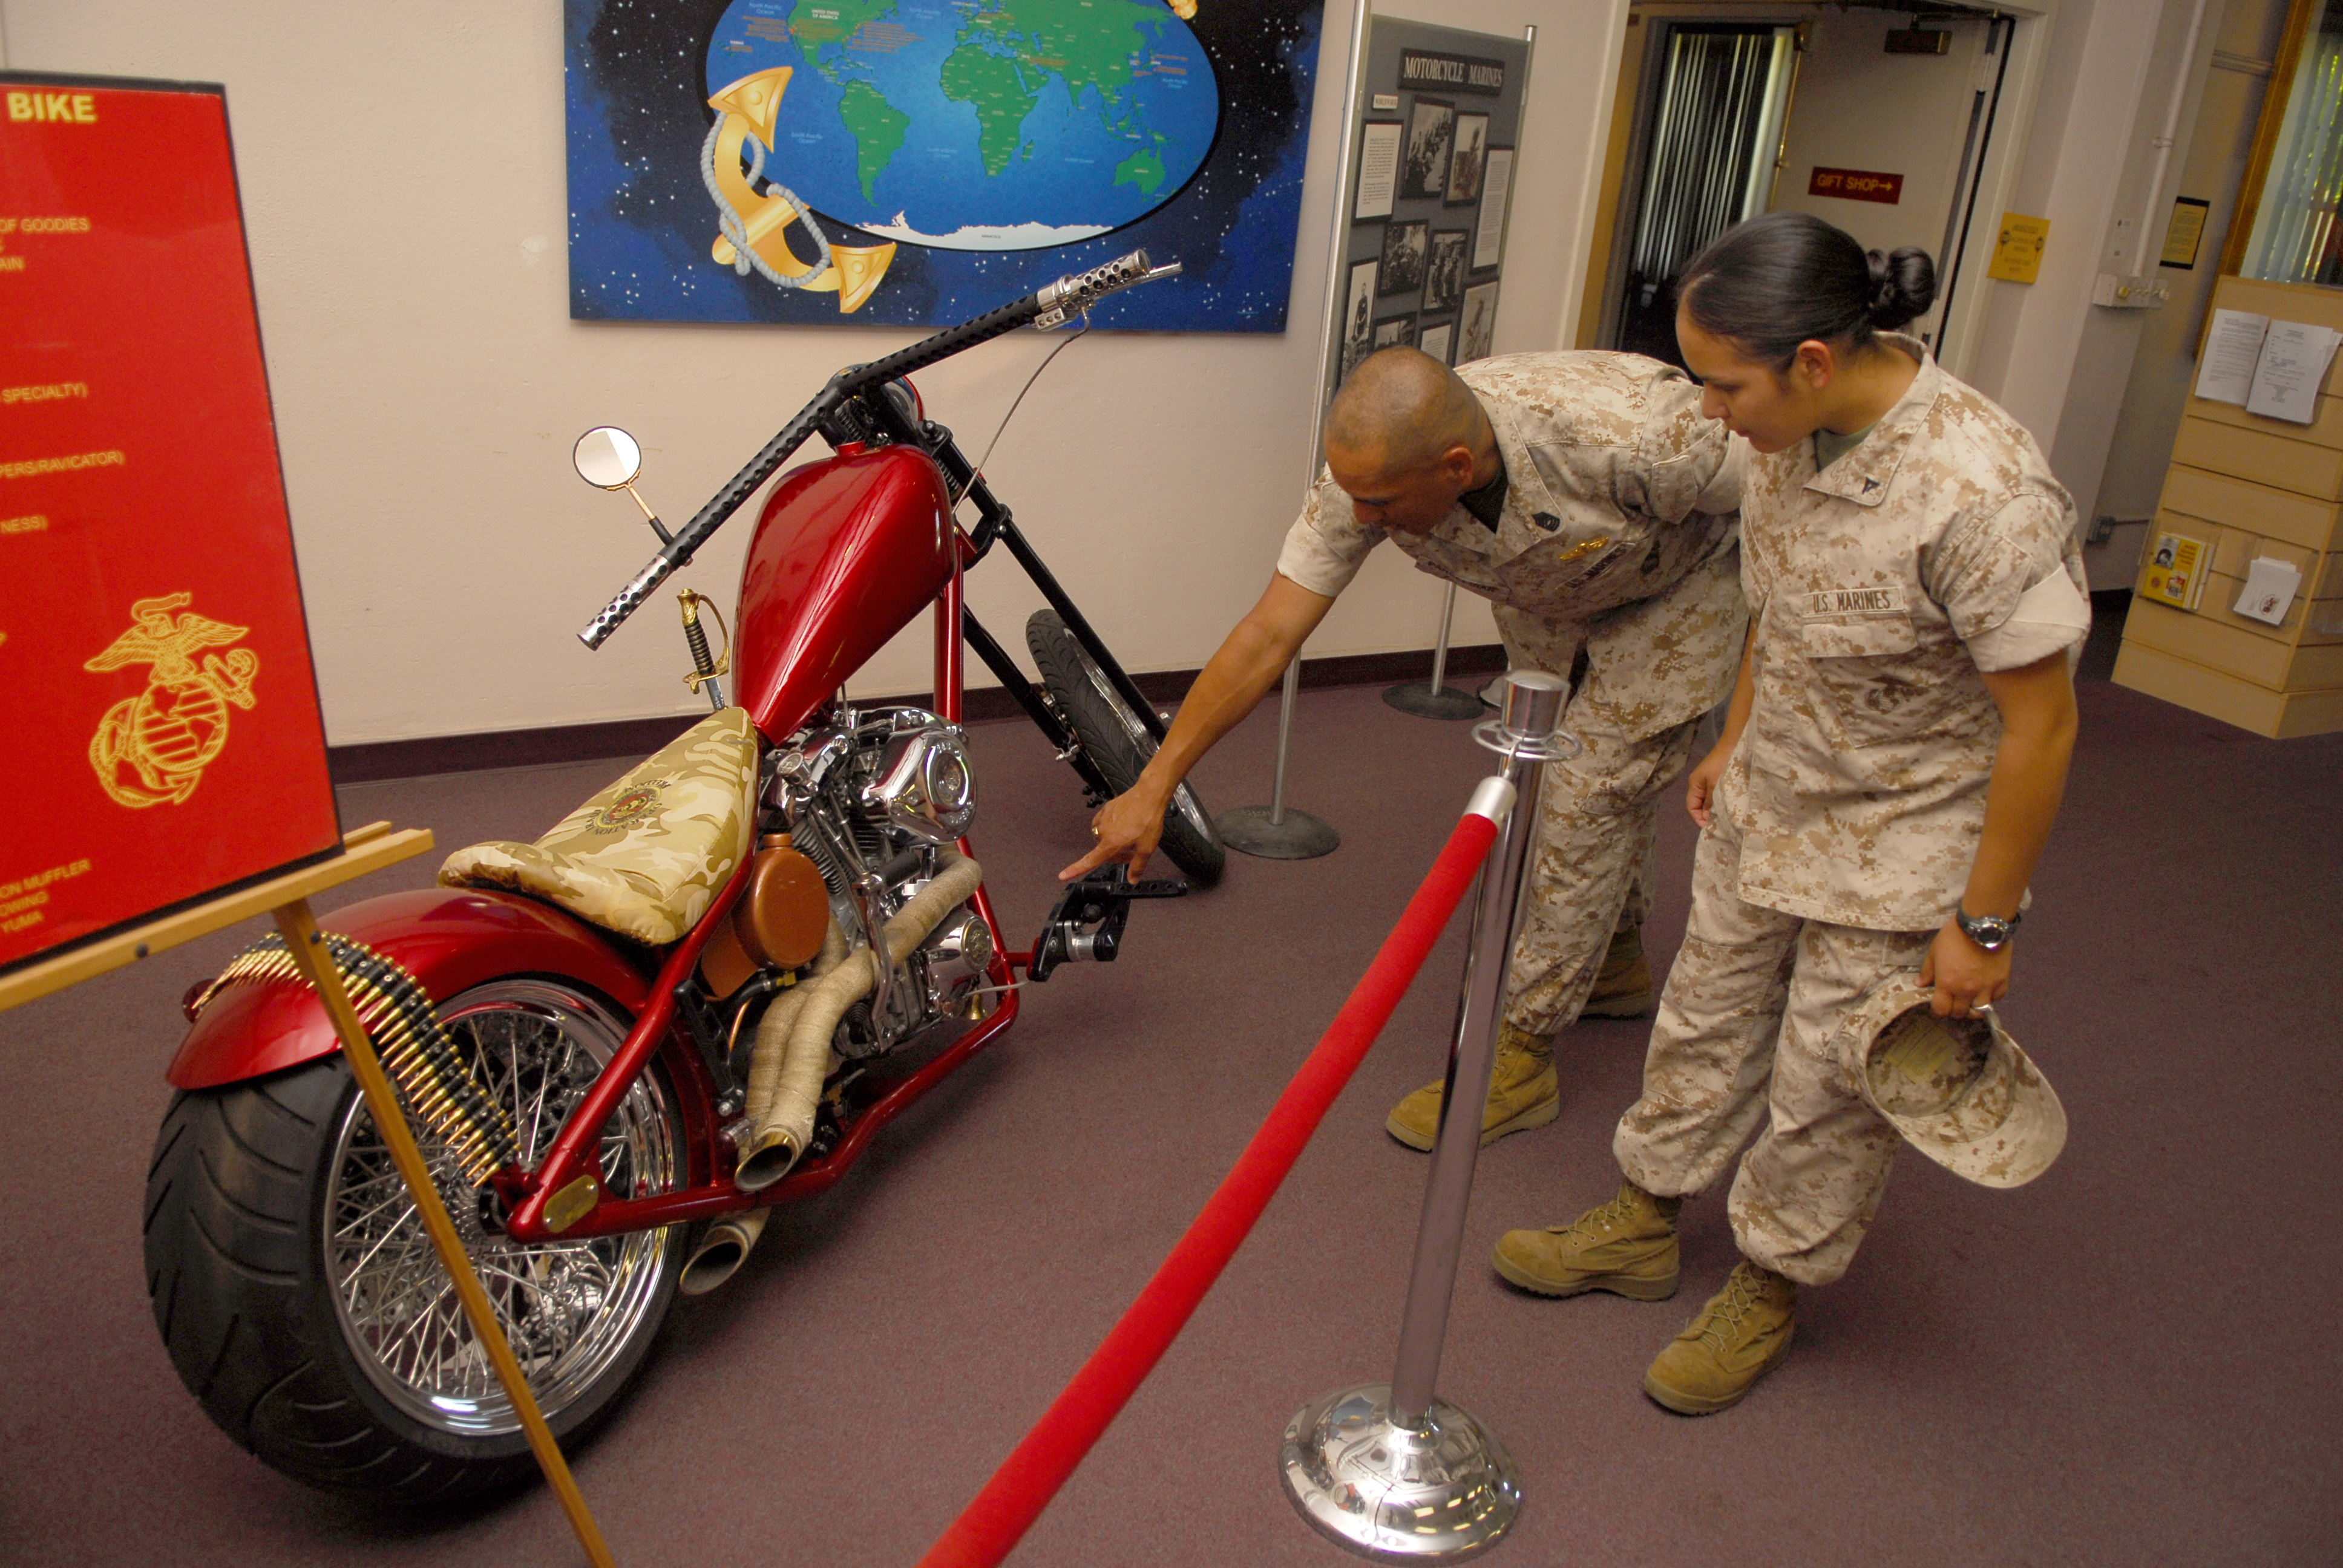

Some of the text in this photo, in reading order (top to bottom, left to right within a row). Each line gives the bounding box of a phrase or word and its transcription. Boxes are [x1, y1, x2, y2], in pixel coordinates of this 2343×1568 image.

[1403, 56, 1503, 88] MOTORCYCLE MARINES
[7, 93, 97, 122] BIKE
[1817, 174, 1879, 192] GIFT SHOP
[21, 218, 89, 232] GOODIES
[2, 382, 88, 402] SPECIALTY)
[1814, 590, 1890, 613] U.S. MARINES
[24, 860, 90, 889] MUFFLER
[1, 910, 43, 932] YUMA
